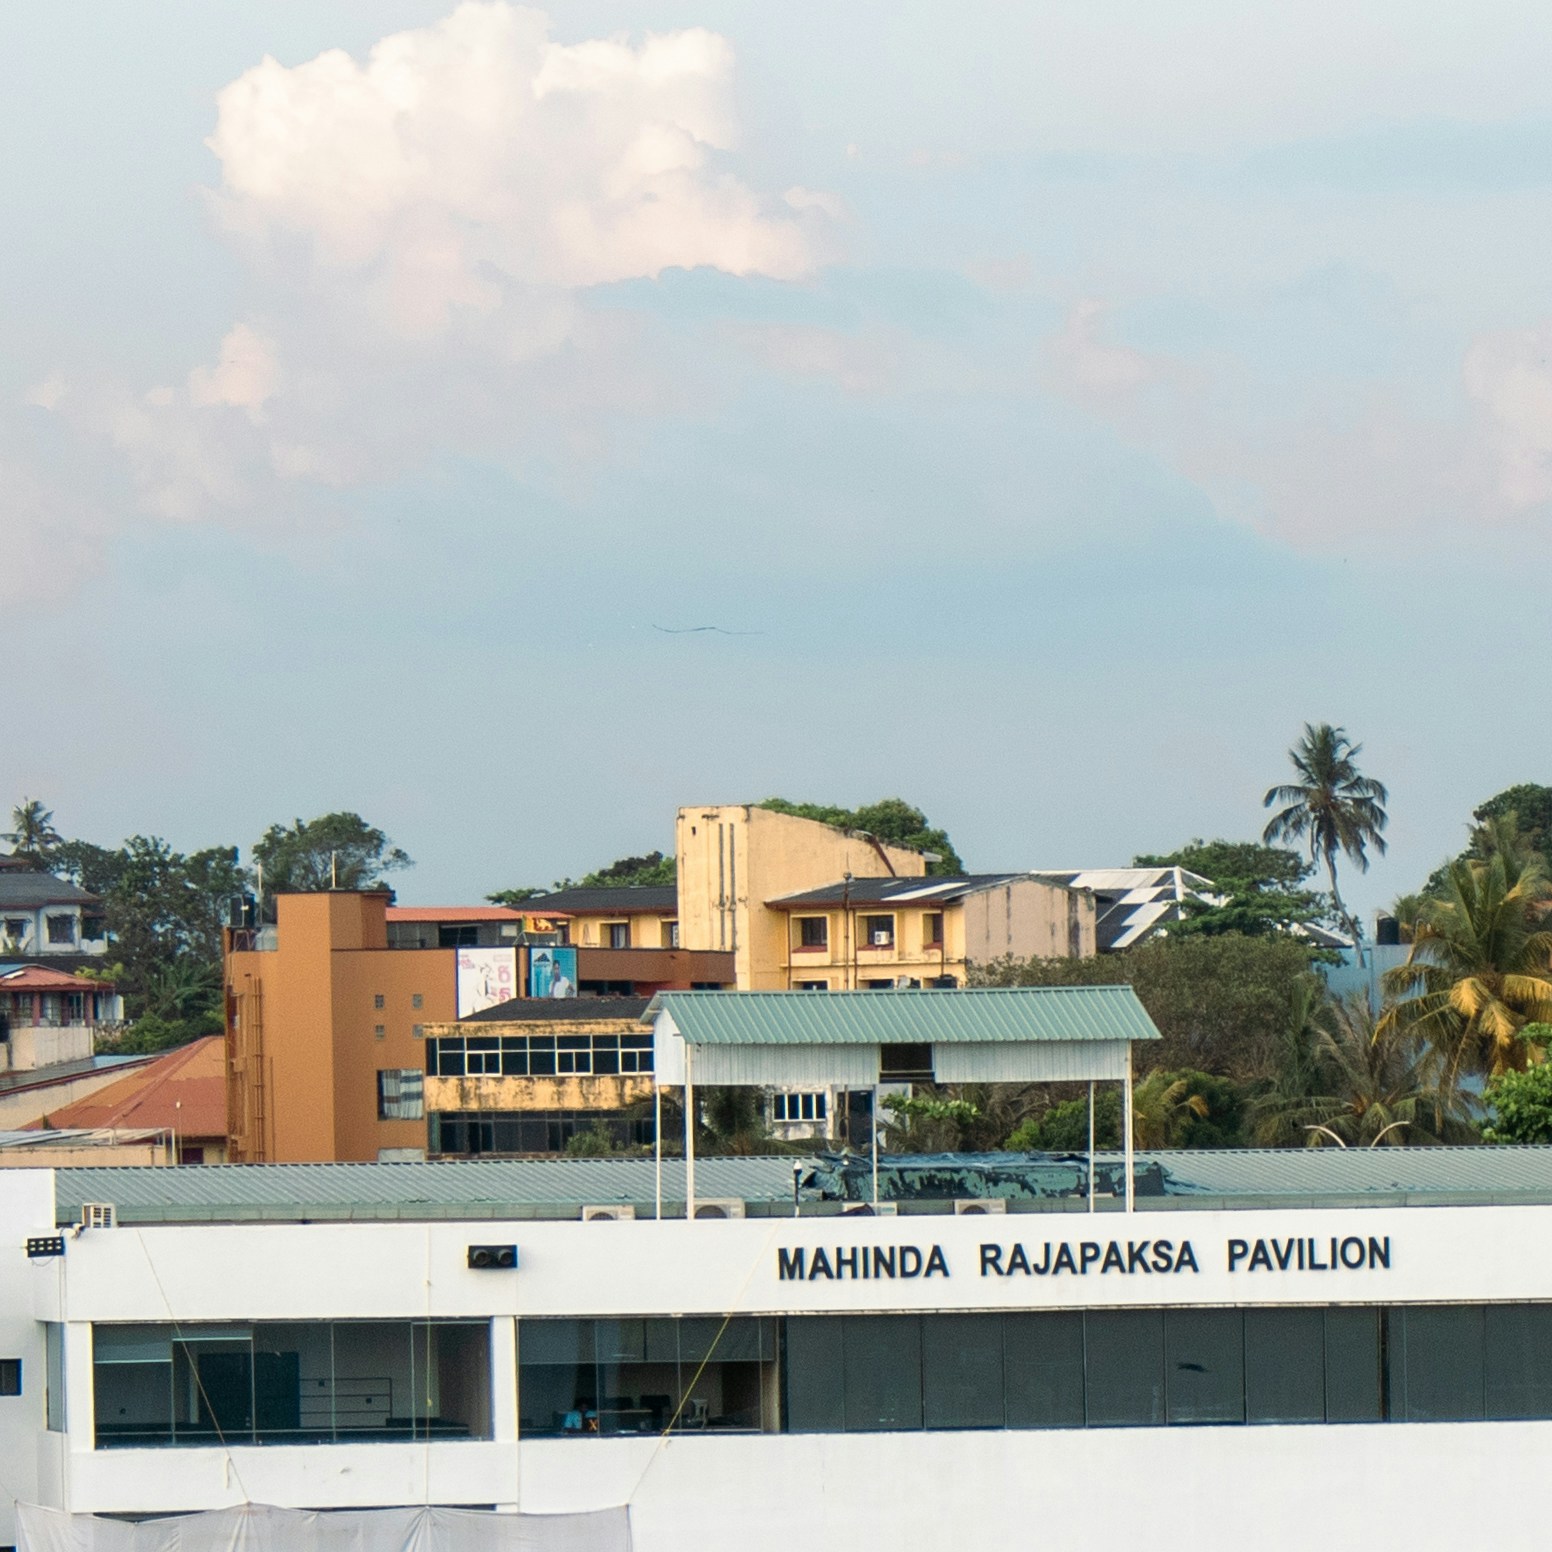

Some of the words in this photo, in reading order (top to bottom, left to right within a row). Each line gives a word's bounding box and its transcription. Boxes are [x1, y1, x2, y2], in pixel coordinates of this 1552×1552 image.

[777, 1244, 950, 1281] MAHINDA
[978, 1239, 1200, 1278] RAJAPAKSA
[1226, 1236, 1391, 1272] PAVILION
